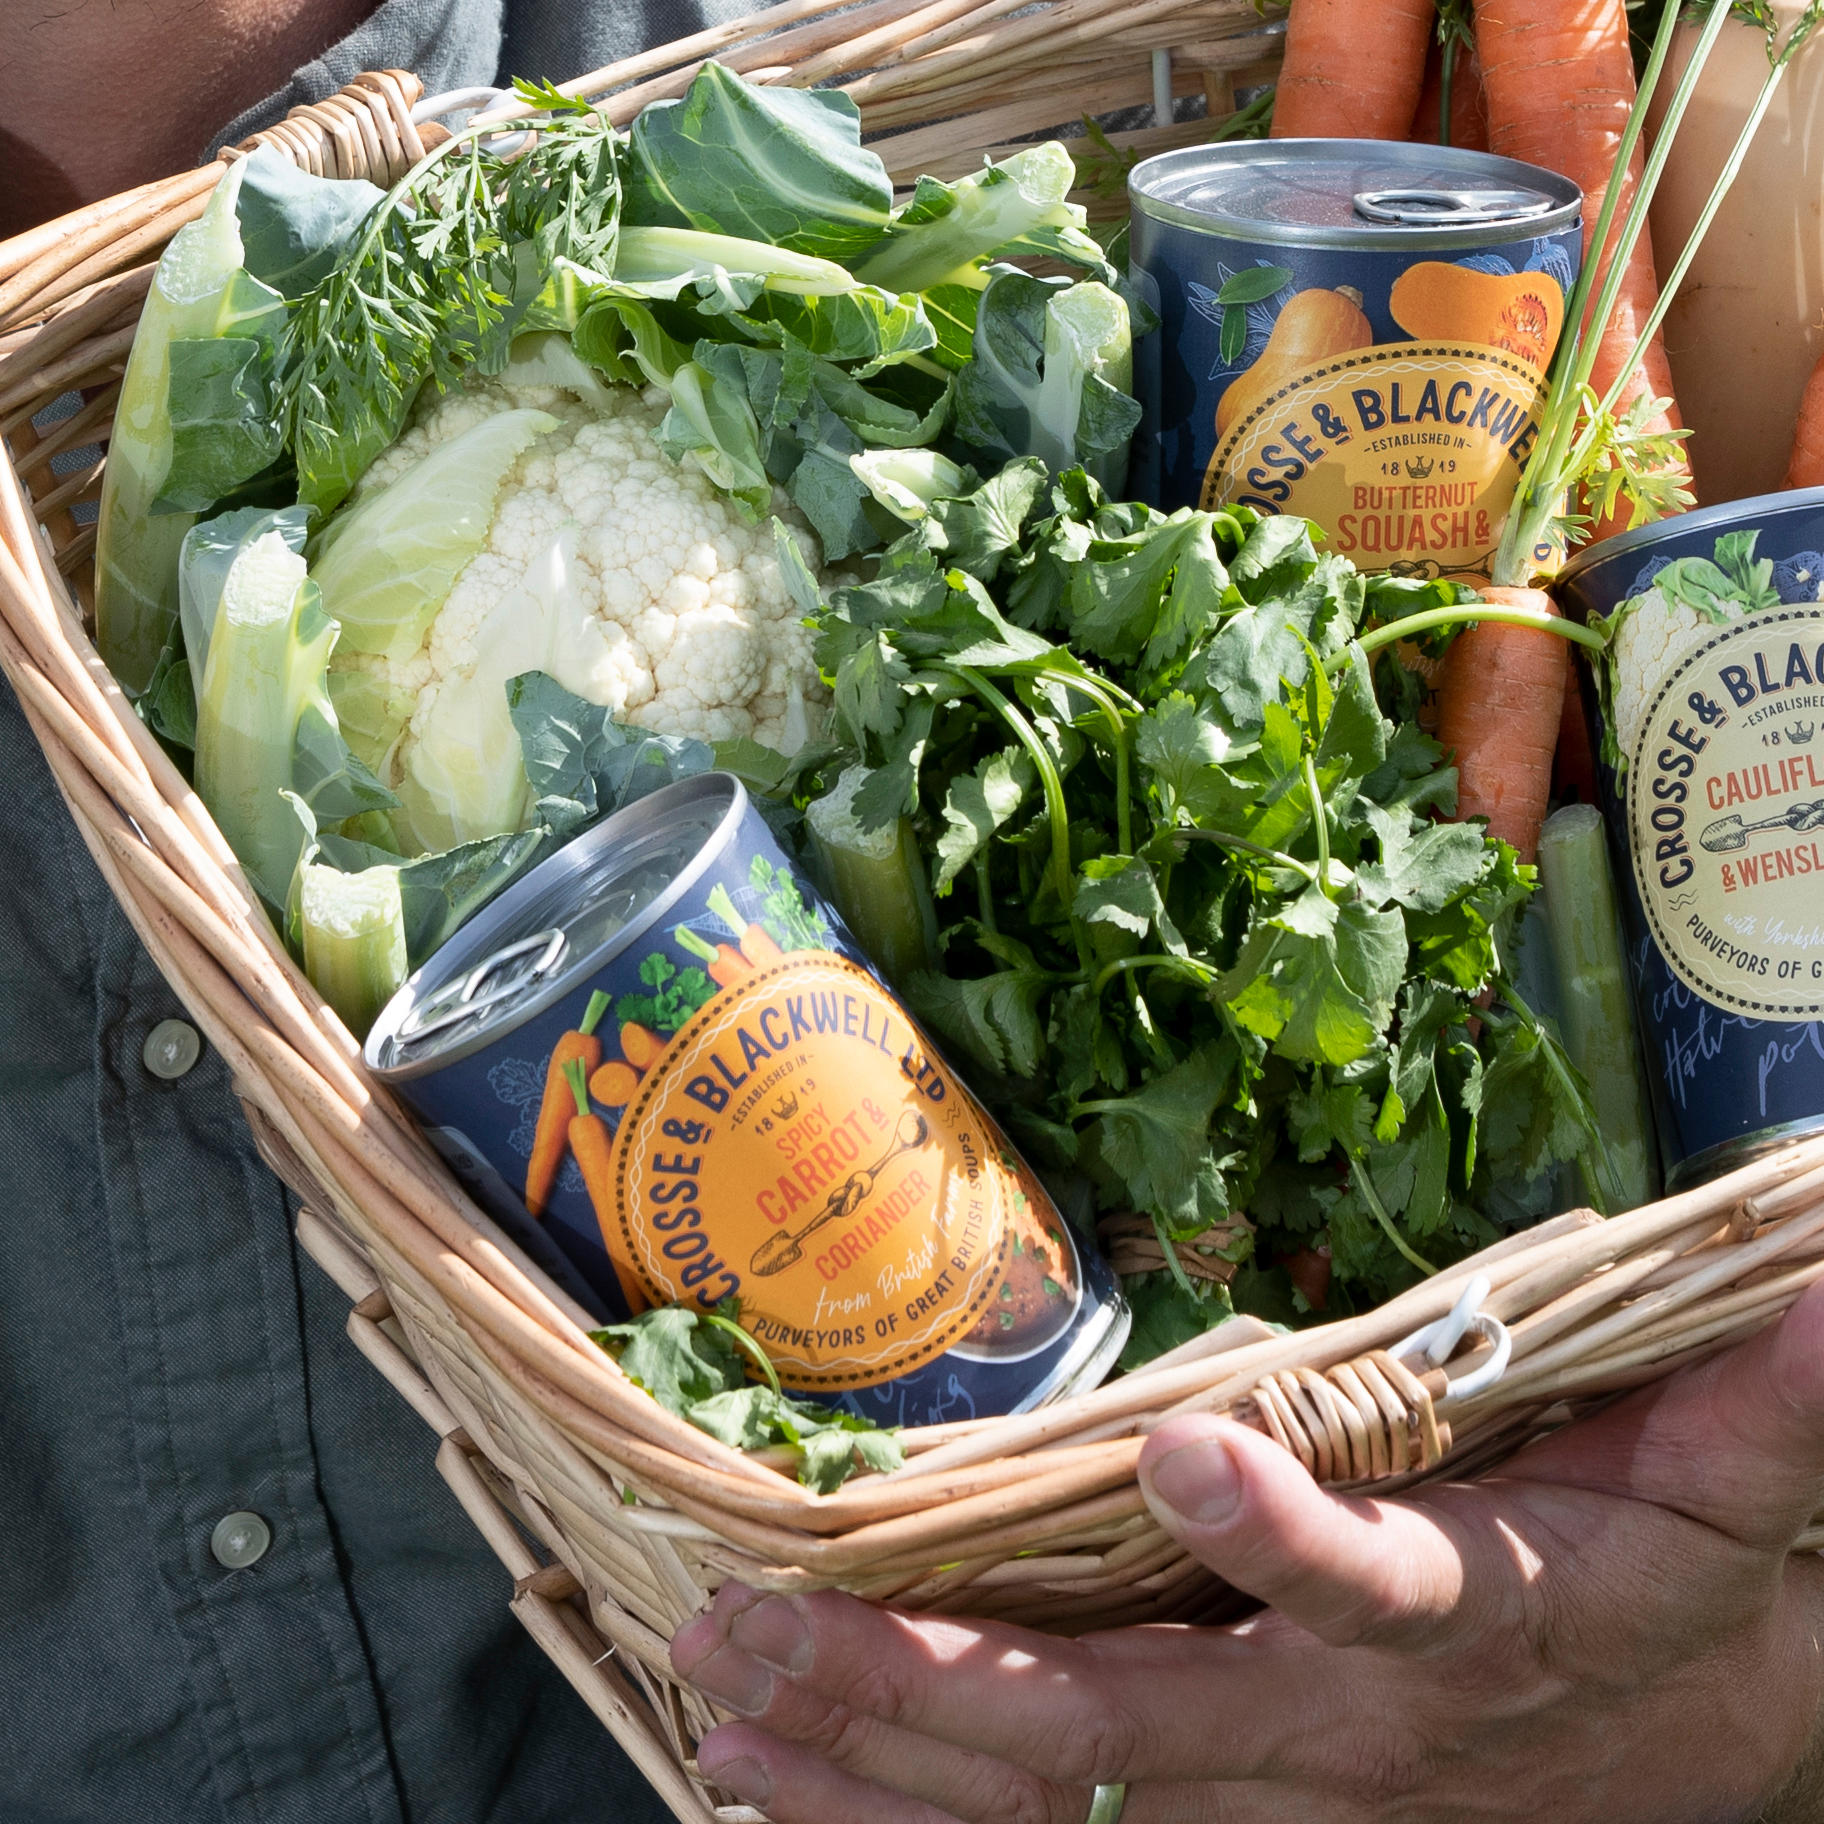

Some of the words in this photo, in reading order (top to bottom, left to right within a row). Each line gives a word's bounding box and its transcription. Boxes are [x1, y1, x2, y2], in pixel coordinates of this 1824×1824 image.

[1312, 403, 1353, 446] &
[1351, 379, 1539, 468] BLACKWE
[1354, 481, 1478, 510] BUTTERNUT
[1381, 462, 1399, 475] 18
[1439, 459, 1456, 473] 19
[1762, 731, 1780, 747] 18
[1651, 719, 1708, 889] CROSSE
[1688, 691, 1727, 729] &
[1686, 914, 1769, 976] PURVEYORS
[1778, 960, 1803, 979] OF
[1723, 913, 1758, 937] with
[684, 991, 893, 1114] BLACKWELL
[900, 1042, 946, 1103] LTD
[661, 1117, 712, 1145] &
[754, 1117, 774, 1137] 18
[799, 1078, 816, 1097] 19
[776, 1102, 833, 1160] SPICY
[755, 1110, 873, 1226] CARROT
[861, 1097, 891, 1131] &
[958, 1132, 983, 1191] SOUPS
[649, 1153, 741, 1308] CROSSE
[814, 1169, 932, 1282] CORIANDER
[951, 1199, 984, 1272] BRITISH
[813, 1287, 872, 1326] from
[876, 1233, 940, 1300] British
[906, 1270, 955, 1322] GREAT
[753, 1317, 866, 1349] PURVEYORS
[876, 1313, 899, 1338] OF
